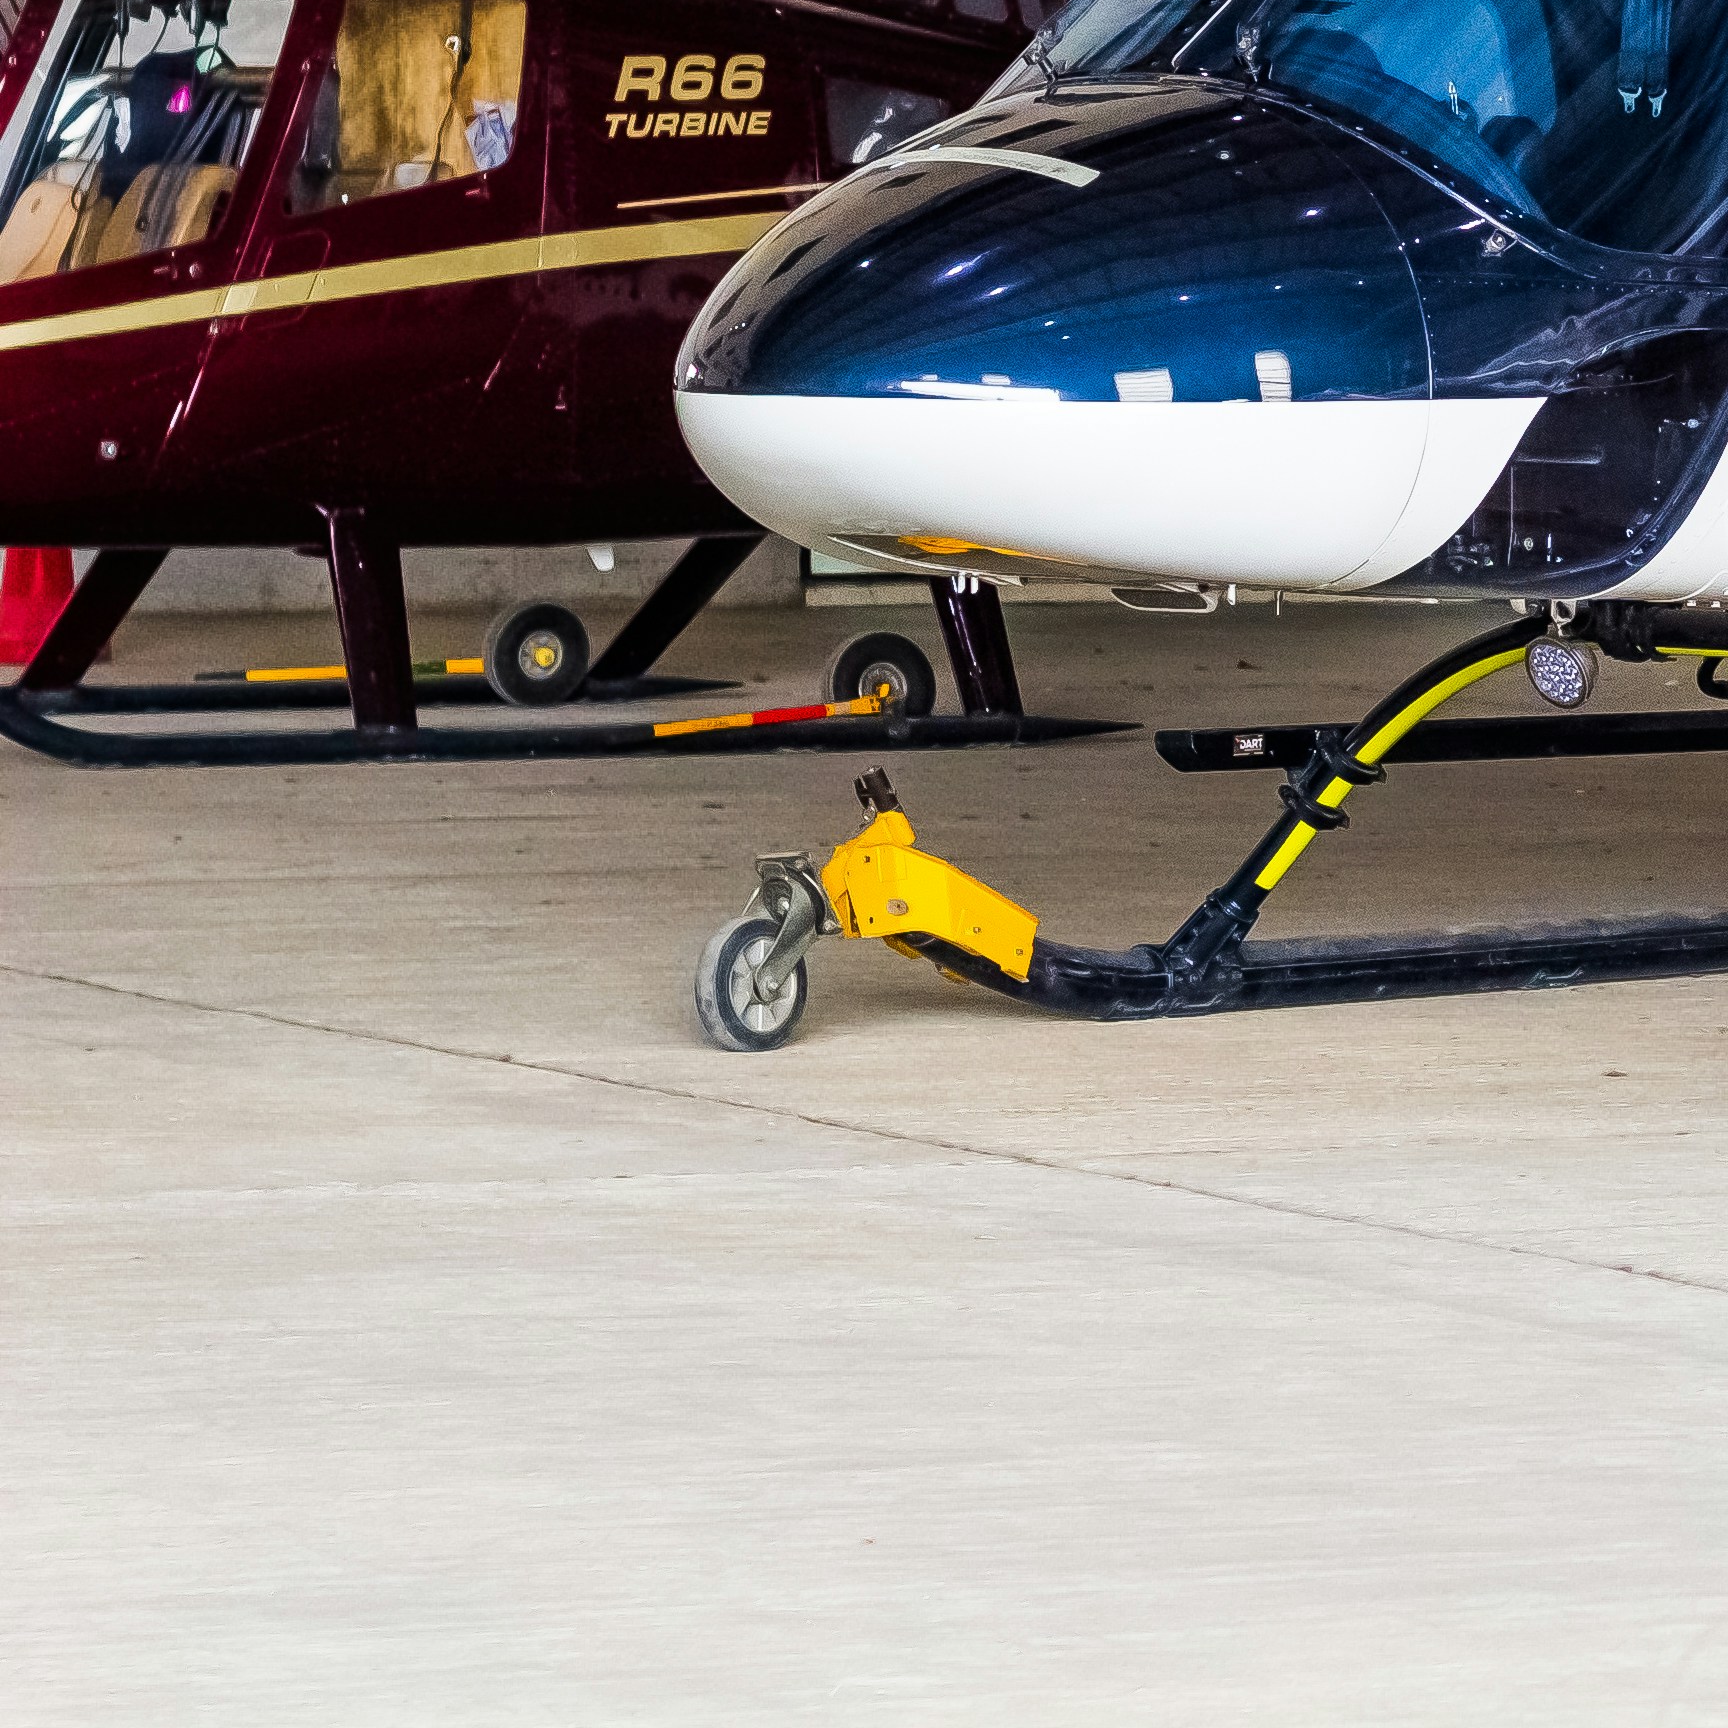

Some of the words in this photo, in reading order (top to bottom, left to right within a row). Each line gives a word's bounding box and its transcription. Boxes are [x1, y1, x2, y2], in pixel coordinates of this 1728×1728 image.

[614, 54, 766, 102] R66
[605, 111, 772, 139] TURBINE
[1239, 738, 1264, 750] DART
